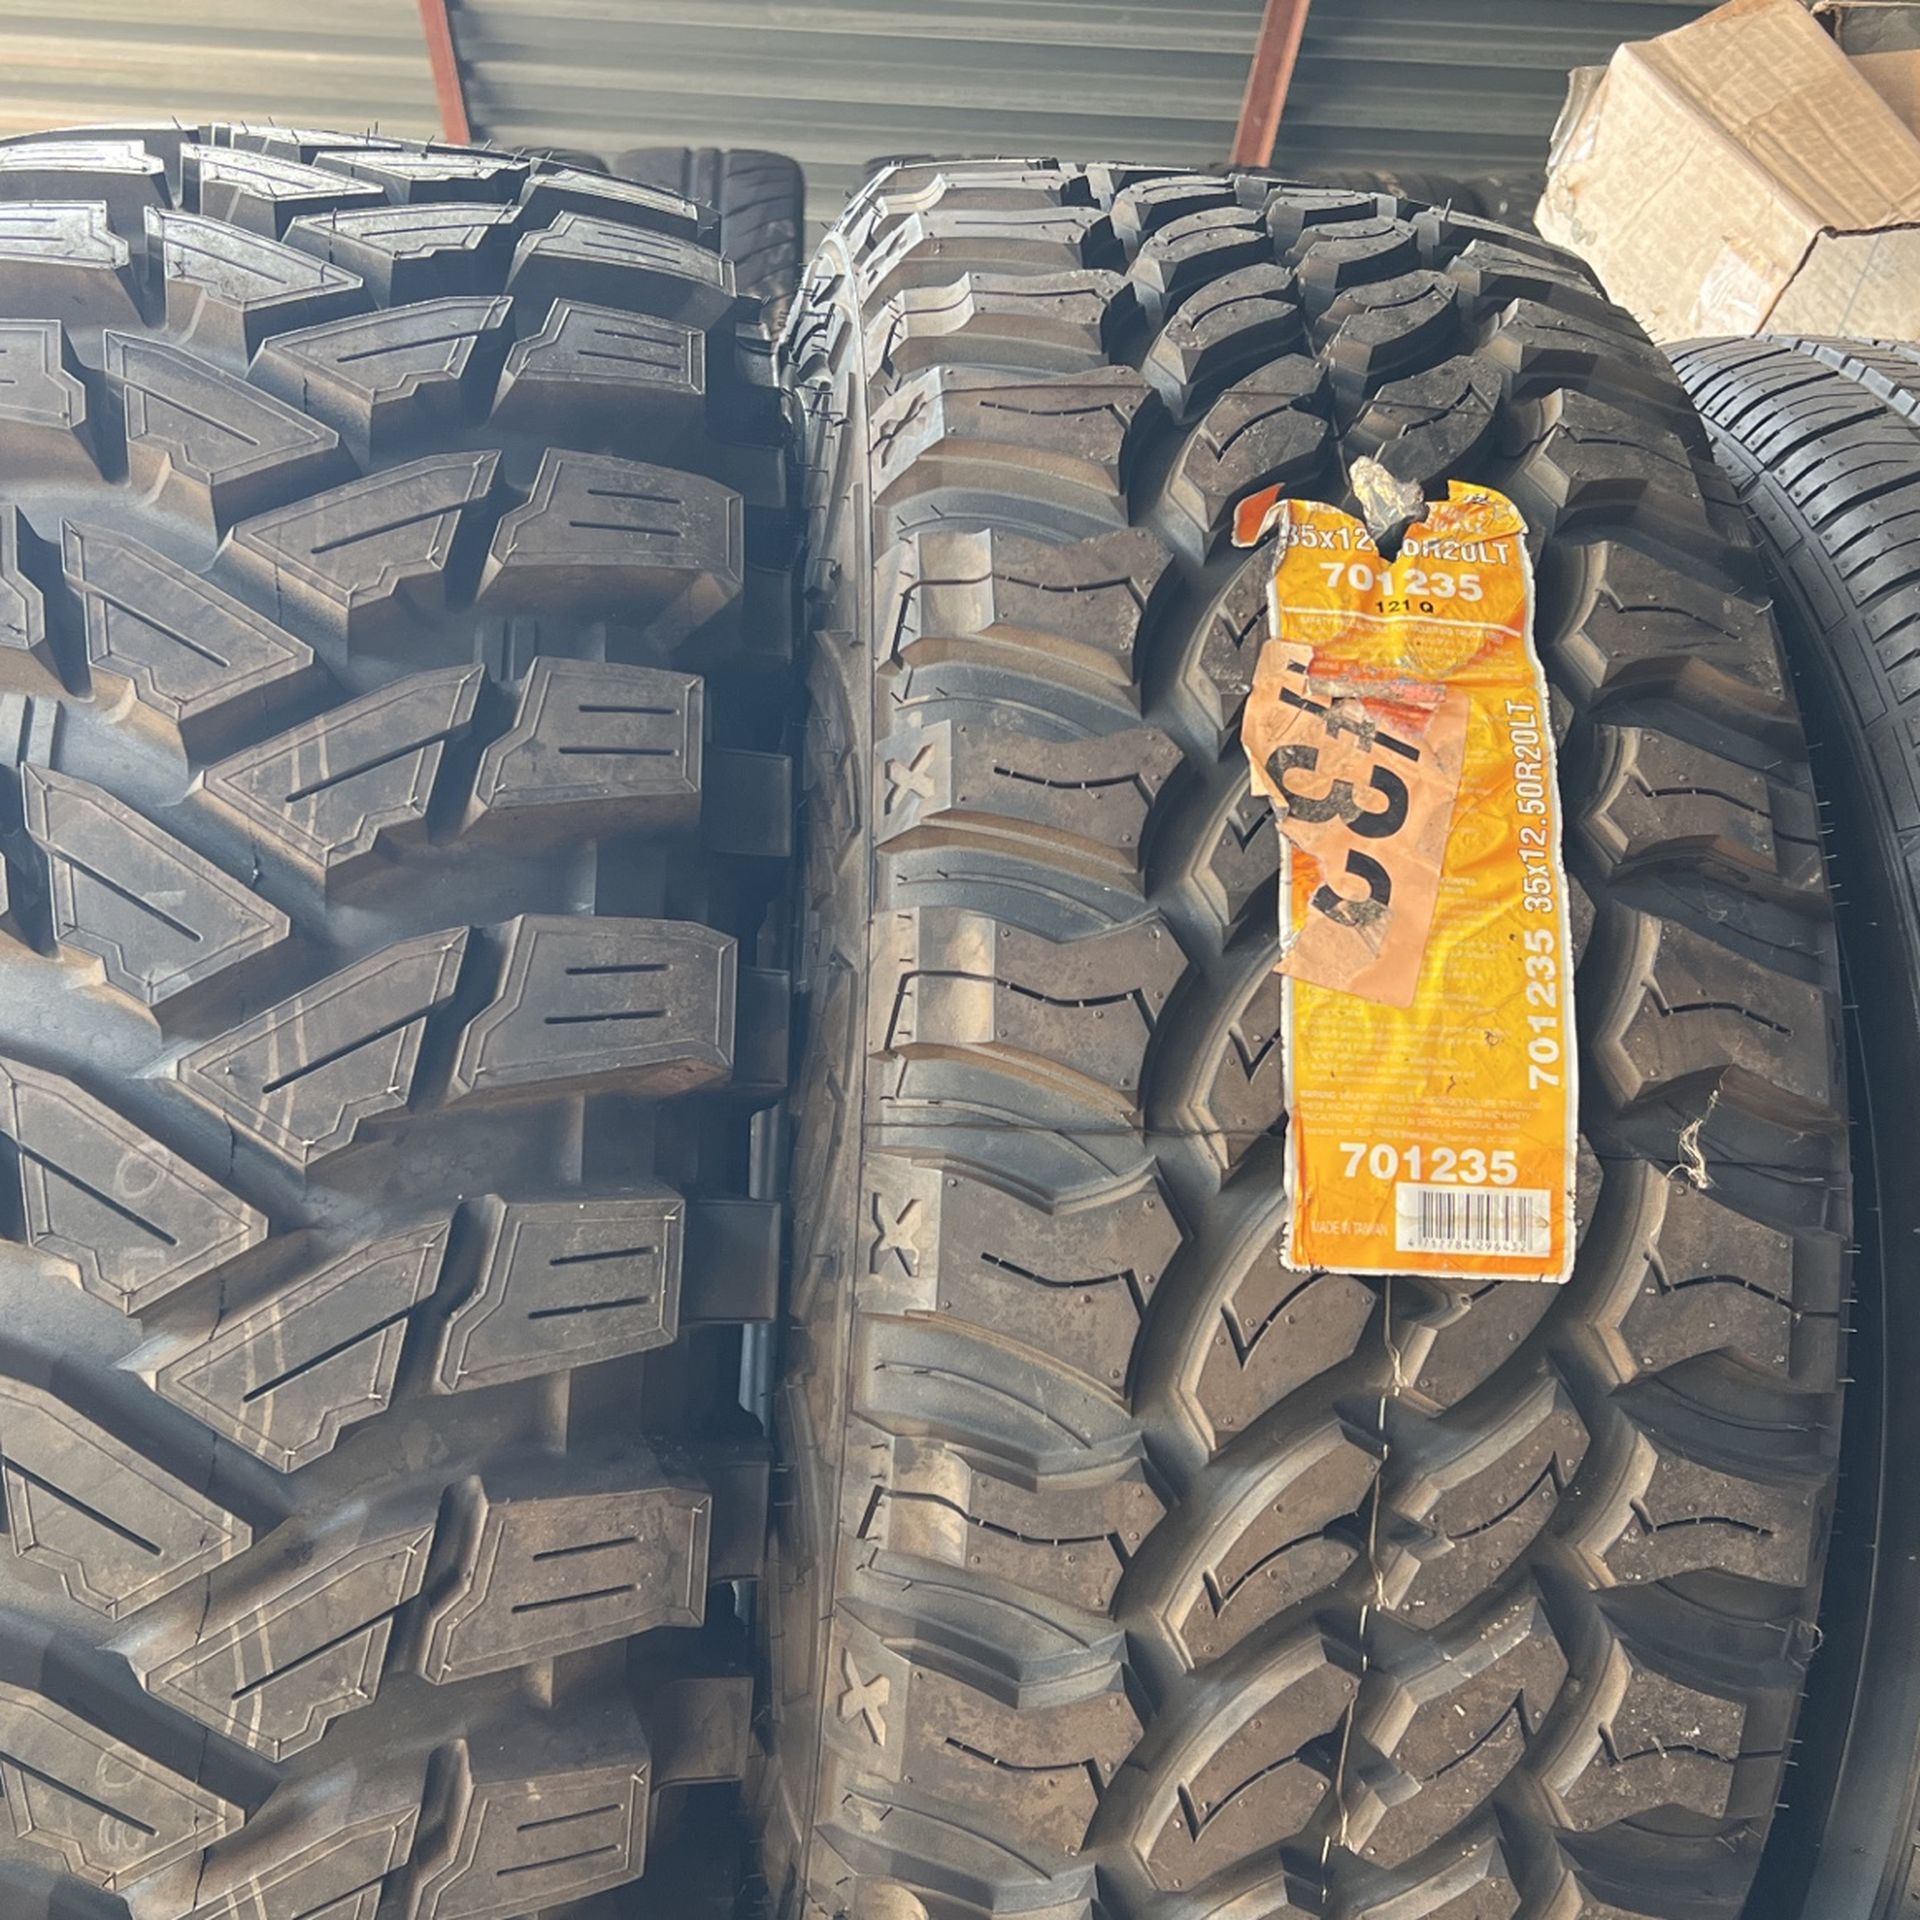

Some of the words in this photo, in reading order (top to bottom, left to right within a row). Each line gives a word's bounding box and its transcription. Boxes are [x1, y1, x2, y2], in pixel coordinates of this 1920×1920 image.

[1286, 524, 1510, 566] 35x120R20LT
[1320, 561, 1483, 602] 701235
[1376, 599, 1410, 615] 121
[1420, 601, 1434, 615] Q
[1504, 700, 1553, 914] 35x12.50R20LT
[1524, 928, 1560, 1090] 701235
[1339, 1142, 1518, 1186] 701235
